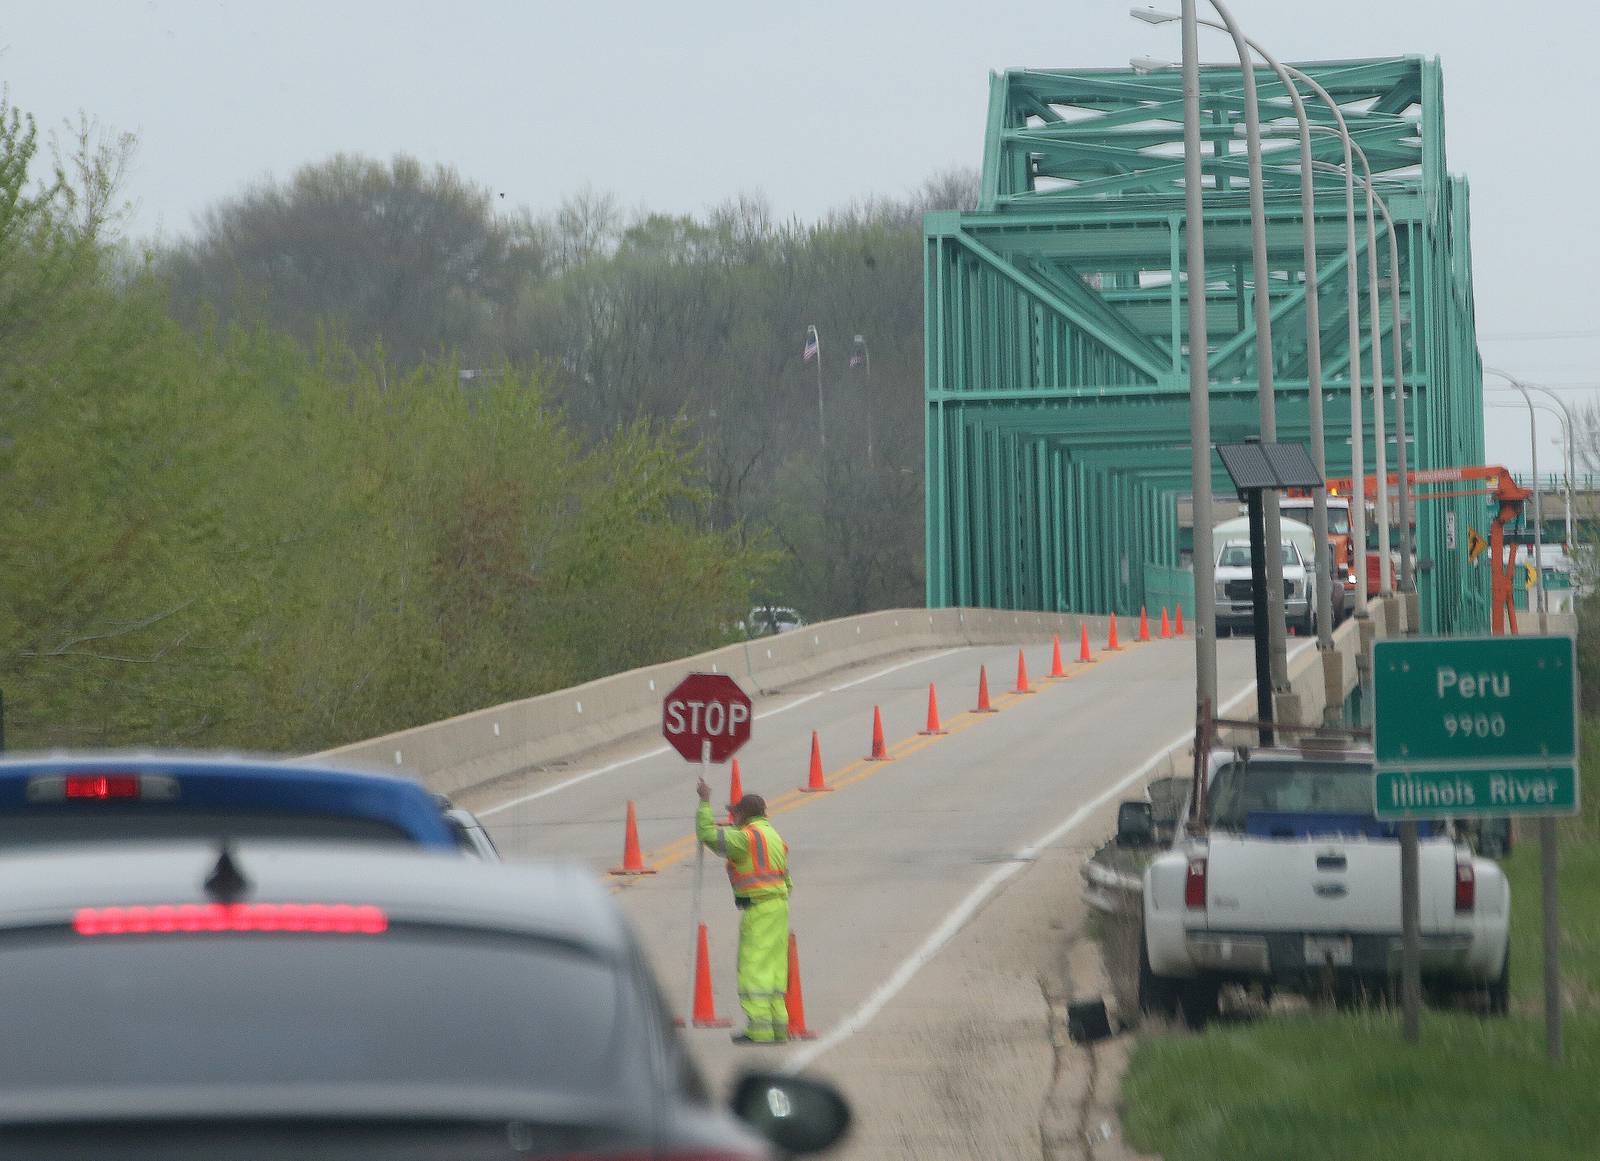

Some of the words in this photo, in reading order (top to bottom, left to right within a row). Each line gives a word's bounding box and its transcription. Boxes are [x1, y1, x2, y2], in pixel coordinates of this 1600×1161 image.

[1437, 665, 1510, 698] Peru
[666, 700, 748, 737] STOP
[1444, 713, 1506, 737] 9900
[1391, 776, 1476, 807] Illinois
[1489, 772, 1558, 804] River
